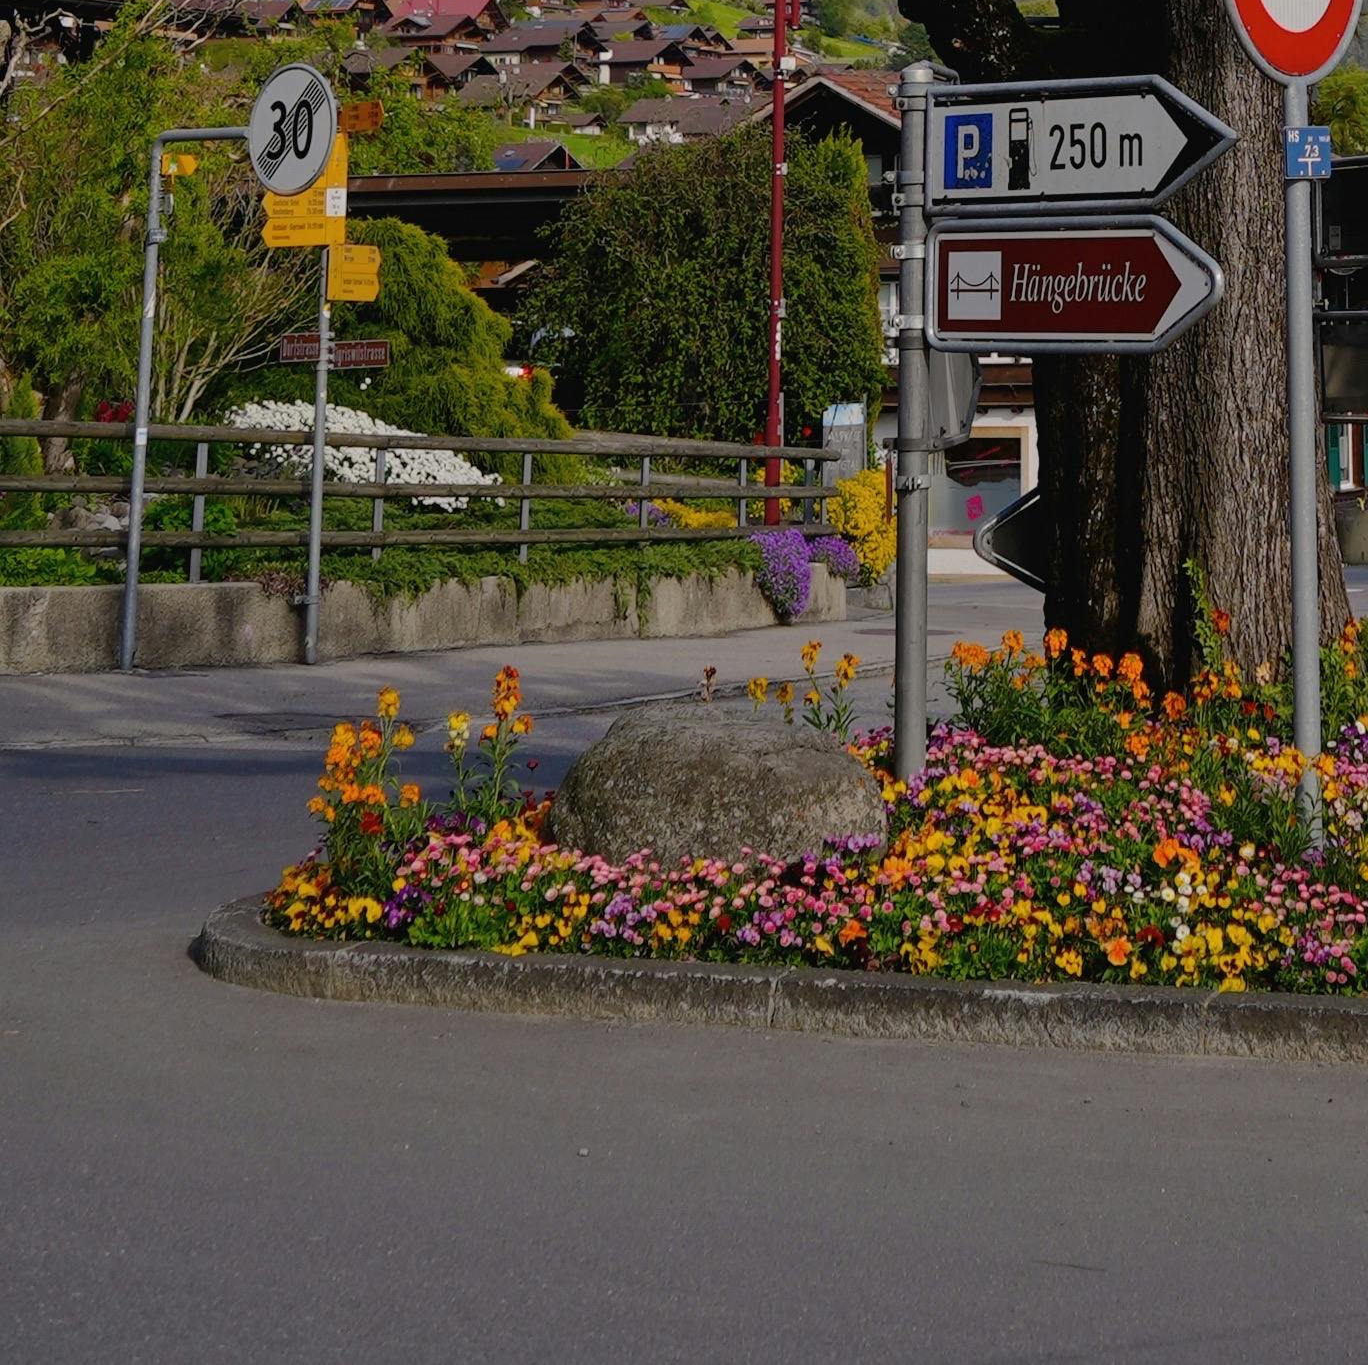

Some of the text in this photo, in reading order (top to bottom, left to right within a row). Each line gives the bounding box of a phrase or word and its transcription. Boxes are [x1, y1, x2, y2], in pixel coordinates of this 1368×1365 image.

[265, 99, 313, 160] 30
[957, 122, 1143, 179] P 250 m
[1009, 261, 1147, 314] Hängebrücke
[282, 338, 320, 357] Dorfstrasse
